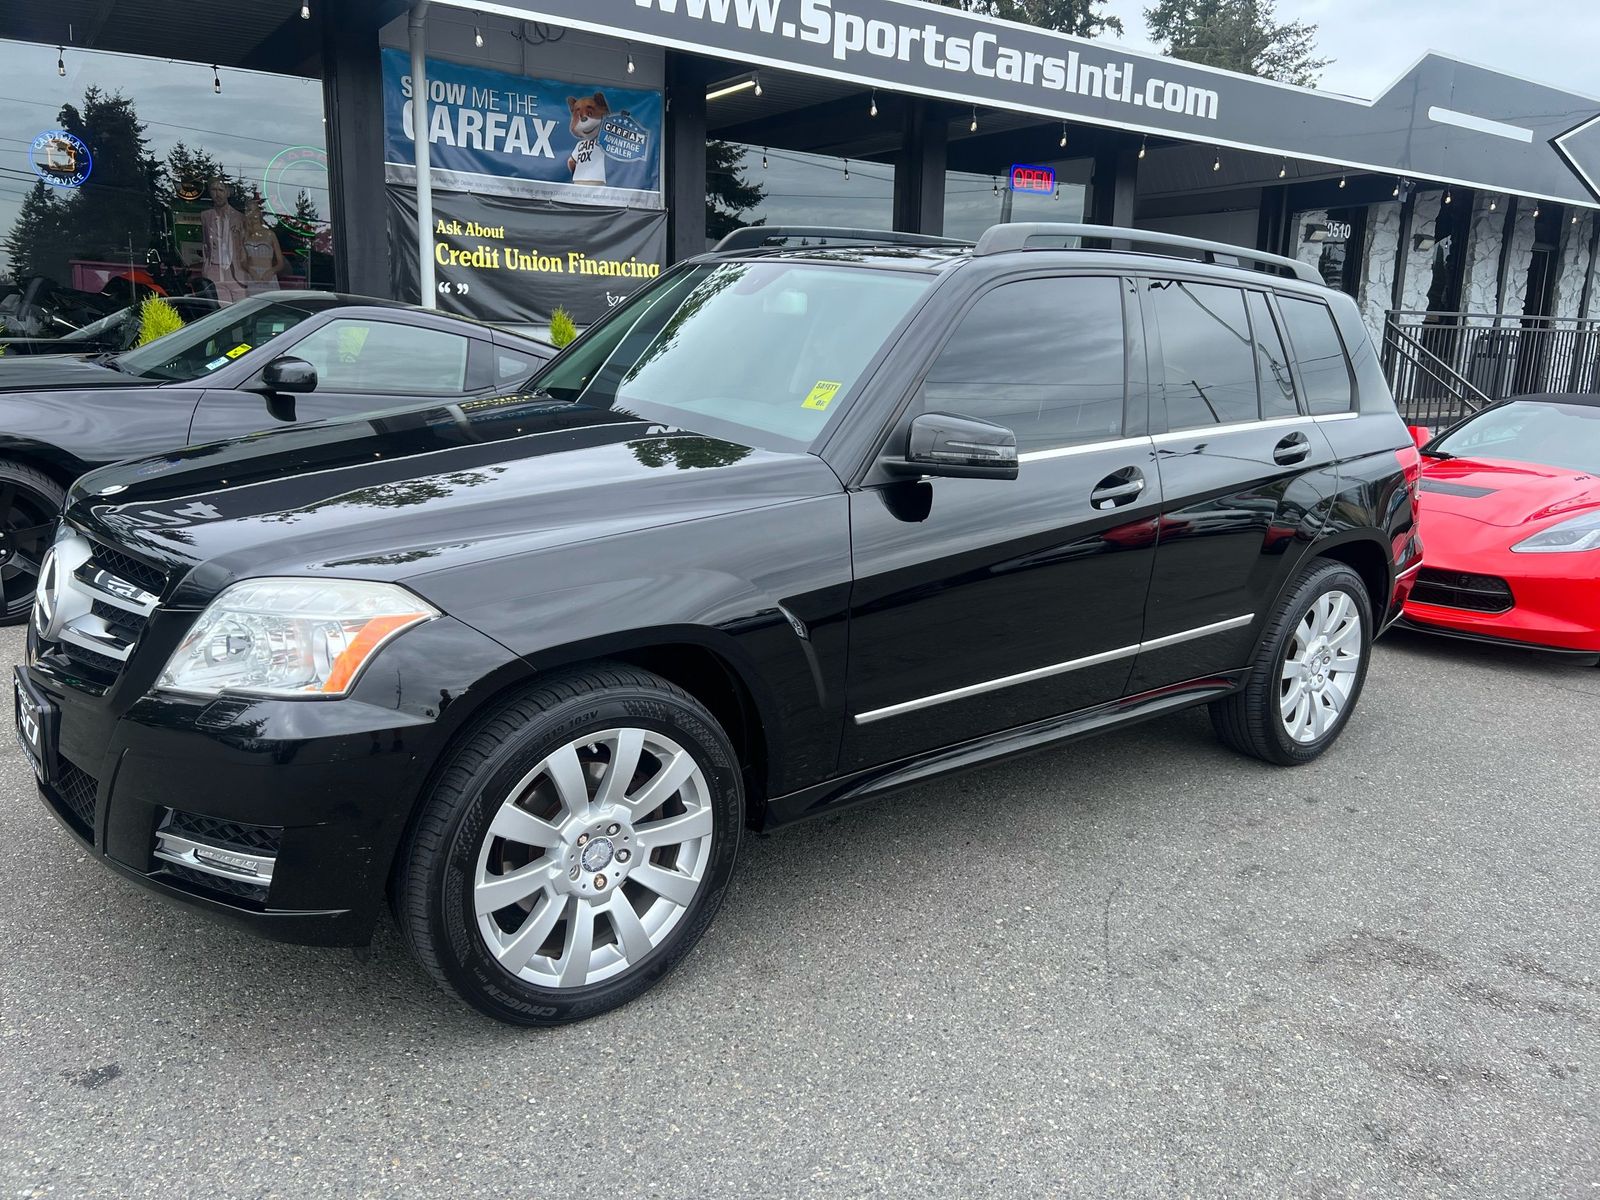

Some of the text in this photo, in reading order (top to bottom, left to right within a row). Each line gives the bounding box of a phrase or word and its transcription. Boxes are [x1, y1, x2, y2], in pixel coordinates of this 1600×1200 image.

[634, 0, 1219, 120] ww.SportsCarsIntl.com
[401, 76, 539, 116] SOW ME THE
[34, 133, 86, 154] CADILLAC
[604, 134, 640, 152] ADVANTAGE
[605, 123, 645, 144] CARFAX
[577, 150, 592, 163] FOX
[578, 140, 595, 152] CAR
[606, 144, 632, 158] DEALER
[1013, 168, 1053, 192] OPEN
[436, 220, 504, 239] Ask About
[435, 243, 499, 269] Credit
[504, 248, 563, 273] Union
[568, 709, 599, 728] 103V
[482, 983, 558, 1017] CRUGEN
